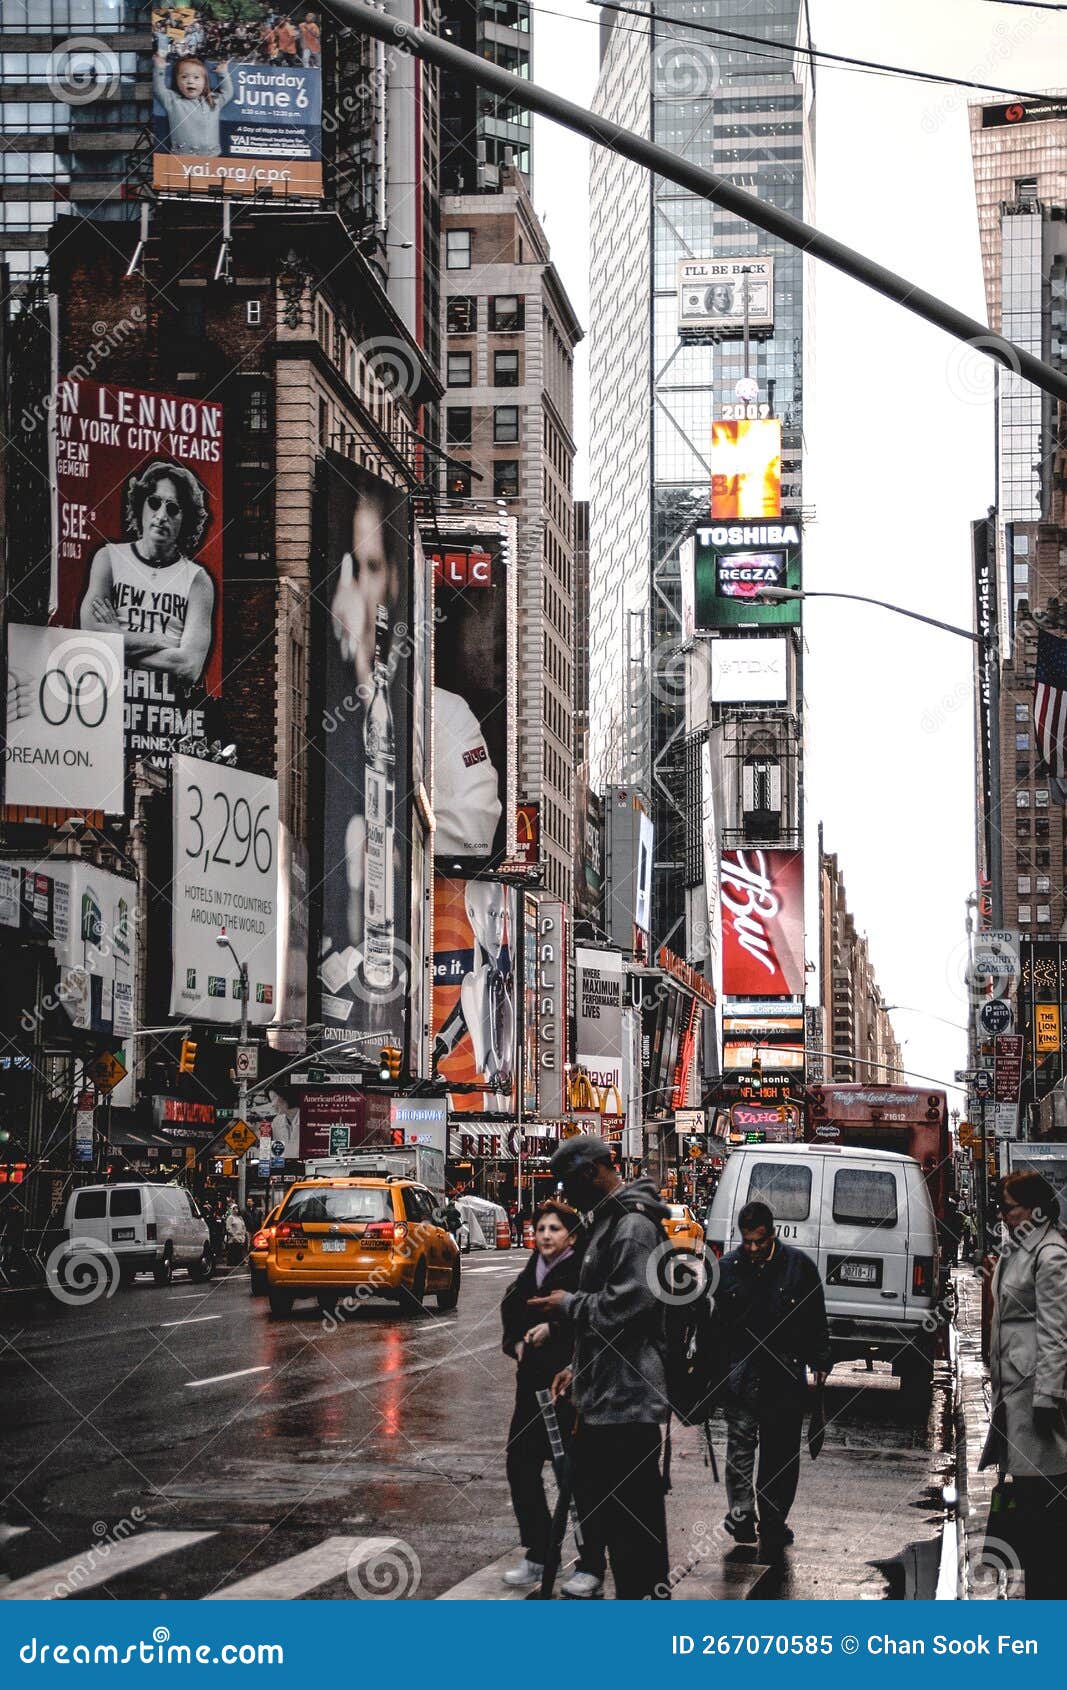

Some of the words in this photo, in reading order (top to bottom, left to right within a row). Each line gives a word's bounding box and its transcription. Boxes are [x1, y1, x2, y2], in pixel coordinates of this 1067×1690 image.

[238, 71, 305, 90] Saturday
[233, 85, 290, 107] June
[296, 89, 308, 108] 6
[230, 135, 249, 145] YAI
[182, 162, 292, 183] yai.org/cpc
[684, 266, 708, 276] I'LL
[711, 265, 729, 275] BE
[722, 404, 770, 420] 2009
[80, 417, 120, 447] YORK
[127, 427, 161, 453] CITY
[169, 433, 220, 463] YEARS
[697, 526, 799, 545] TOSHIBA
[719, 569, 778, 581] REGZA
[111, 582, 146, 610] NEW
[151, 591, 189, 625] YORK
[128, 607, 170, 634] CITY
[147, 704, 205, 737] FAME
[131, 734, 177, 752] ANNEX
[62, 752, 93, 767] ON.
[185, 785, 273, 874] 3,296
[184, 885, 213, 903] HOTELS
[213, 890, 222, 904] IN
[223, 892, 232, 906] 77
[233, 894, 272, 915] COUNTRIES
[191, 908, 223, 927] AROUND
[224, 914, 238, 929] THE
[239, 918, 266, 935] WORLD.
[980, 933, 1012, 942] NYPD
[451, 960, 465, 975] it.
[583, 968, 601, 979] WHERE
[540, 917, 555, 1069] PALACE
[582, 979, 619, 996] MAXIMUM
[582, 993, 619, 1008] PERFORMANCE
[582, 1004, 601, 1019] LIVES
[1038, 1021, 1057, 1034] LION
[1038, 1034, 1058, 1046] KING
[643, 1059, 650, 1067] IS
